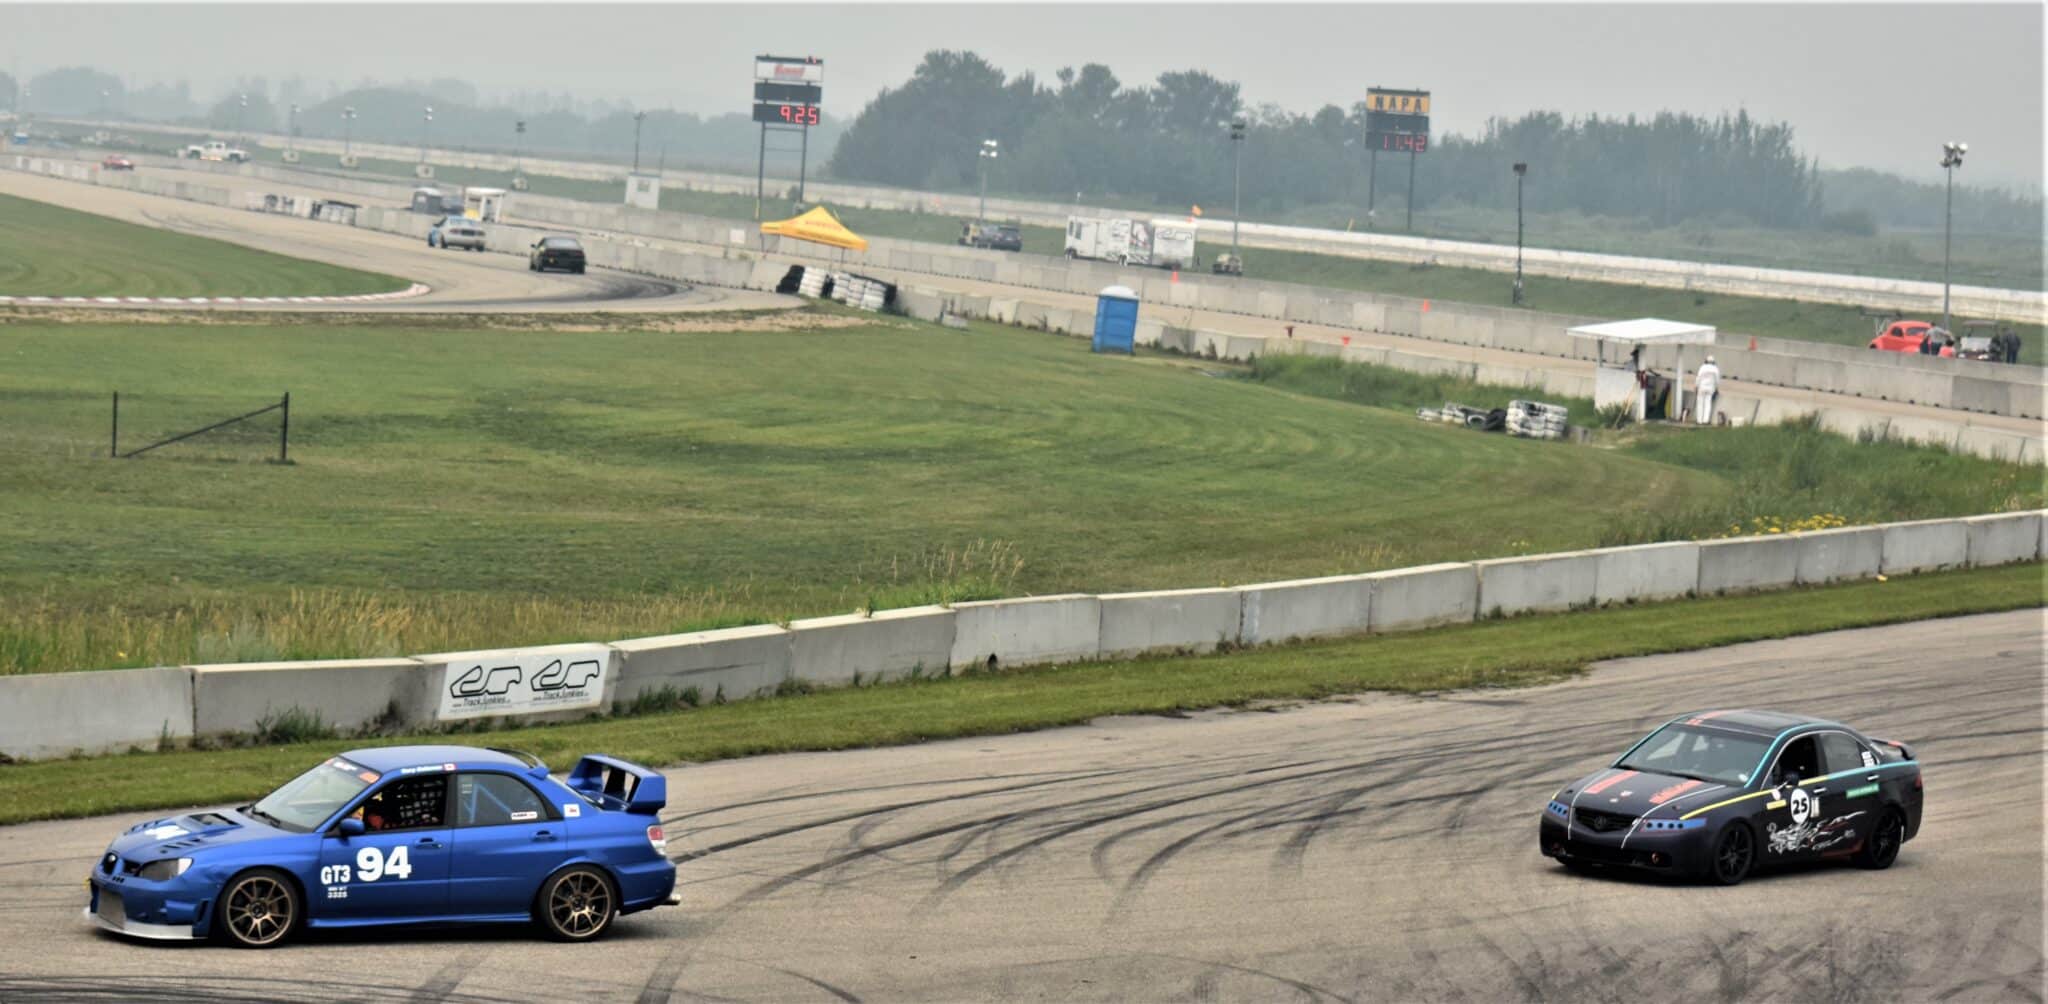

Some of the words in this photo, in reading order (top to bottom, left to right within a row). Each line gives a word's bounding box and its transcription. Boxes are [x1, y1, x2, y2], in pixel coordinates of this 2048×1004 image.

[780, 105, 817, 125] 9.25
[1376, 97, 1422, 113] NAPA
[1792, 798, 1808, 815] 25
[356, 845, 412, 882] 94
[320, 864, 351, 885] GT3
